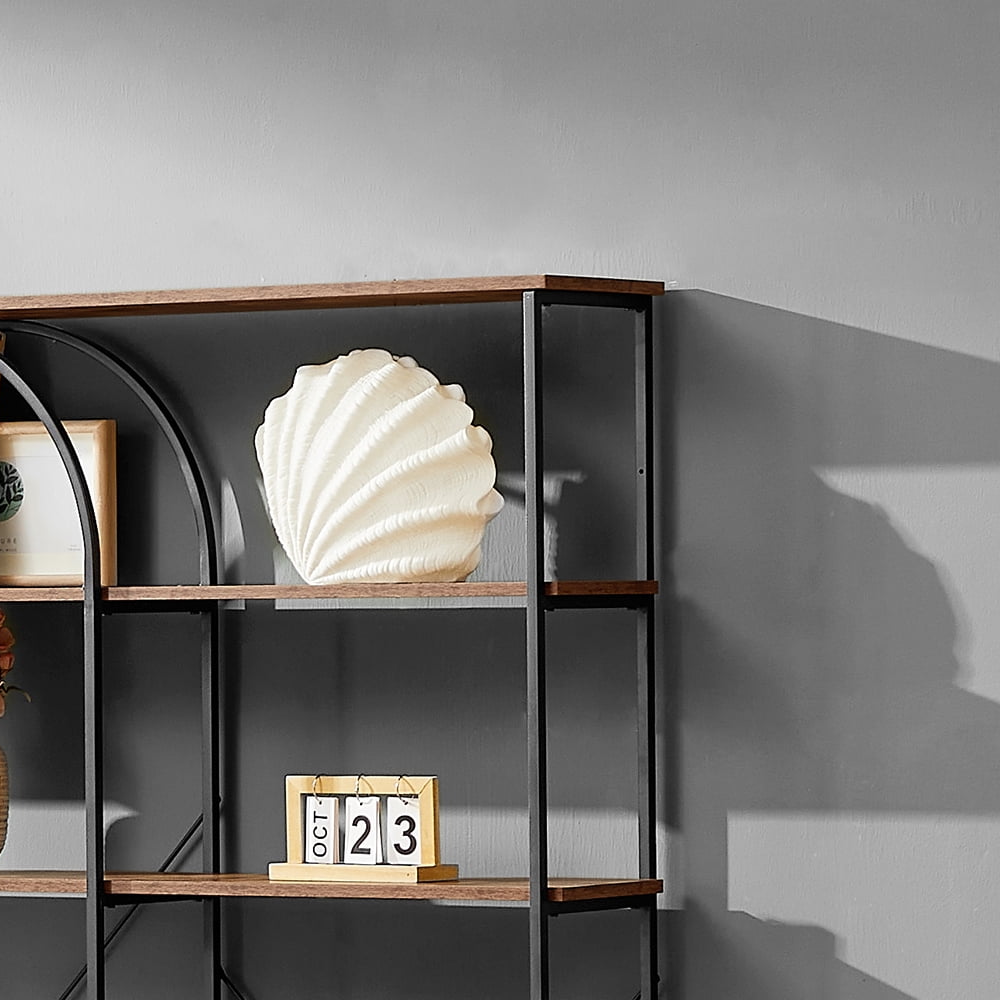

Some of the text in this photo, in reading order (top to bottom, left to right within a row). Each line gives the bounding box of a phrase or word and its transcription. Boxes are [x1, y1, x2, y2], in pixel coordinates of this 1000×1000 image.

[312, 810, 418, 858] OCT 2 3
